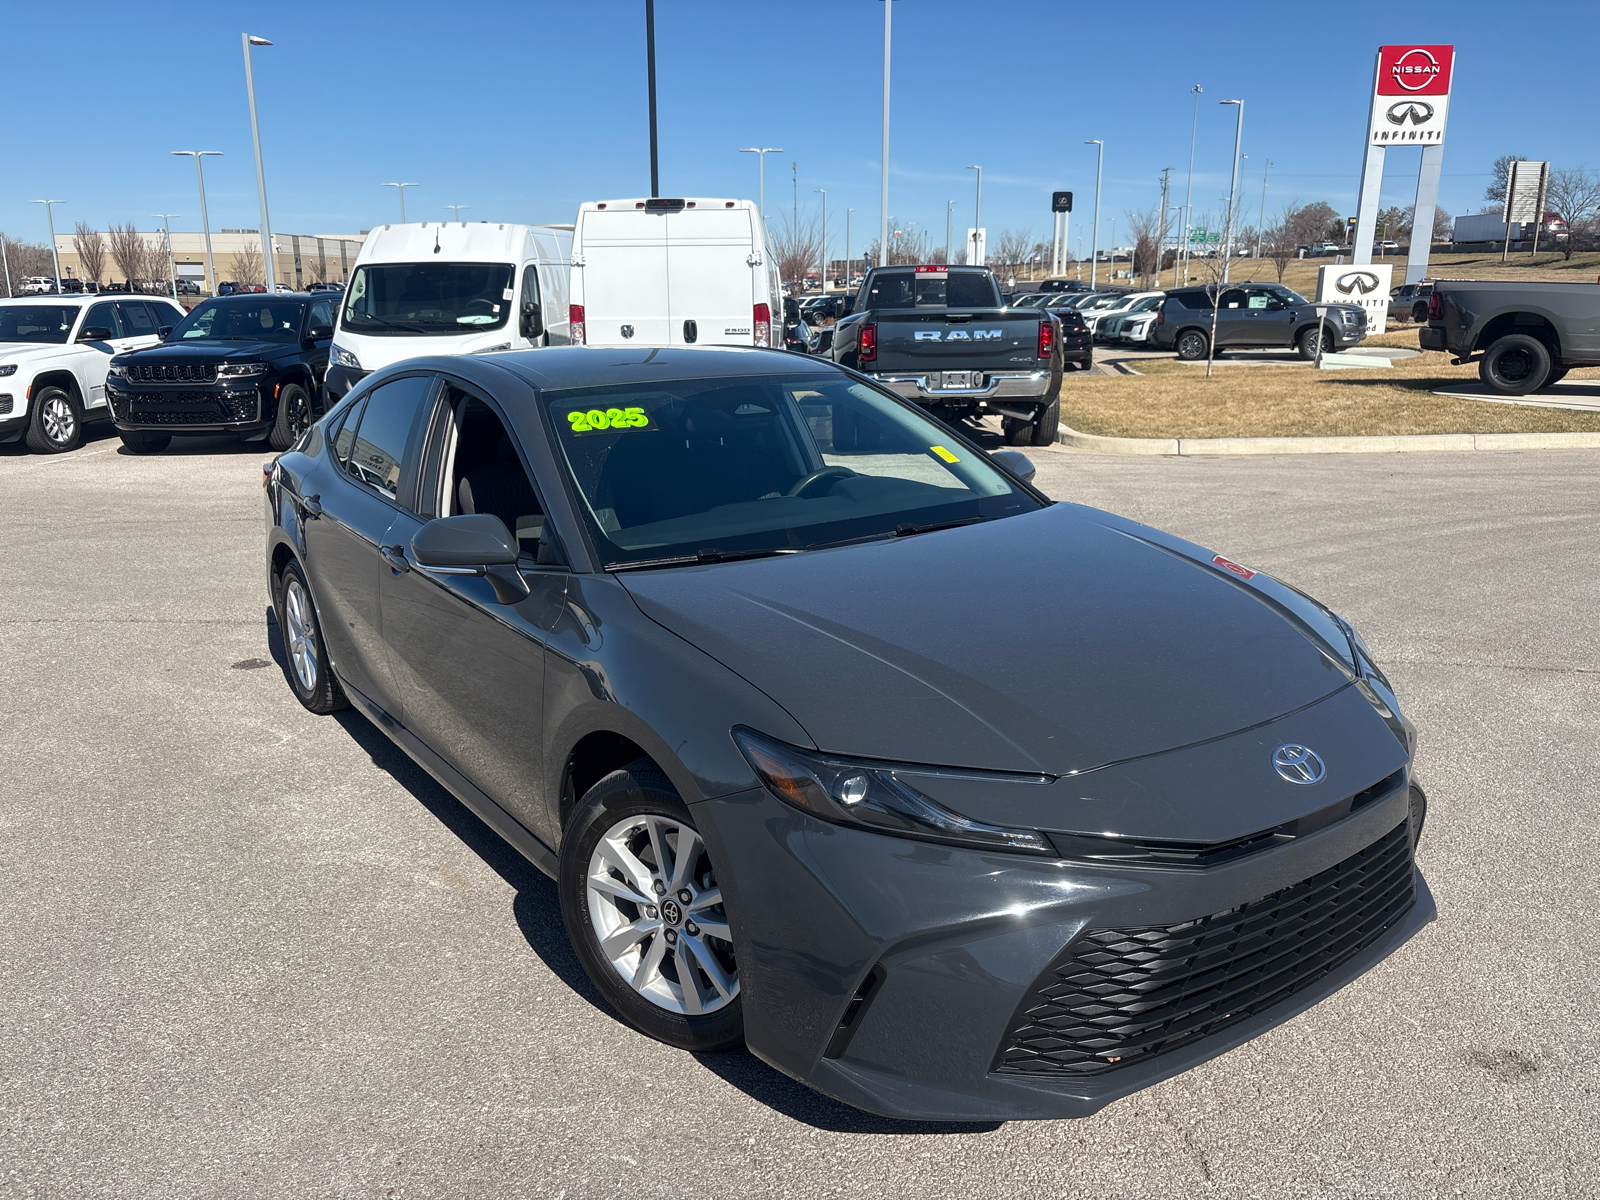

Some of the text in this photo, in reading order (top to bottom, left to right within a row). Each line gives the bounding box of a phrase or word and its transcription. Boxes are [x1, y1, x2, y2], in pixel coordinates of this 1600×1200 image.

[1374, 131, 1441, 140] INFINITI
[1327, 299, 1384, 307] INITI
[914, 330, 1003, 342] RAM
[567, 407, 649, 432] 2025
[627, 788, 685, 811] YOKOHAM
